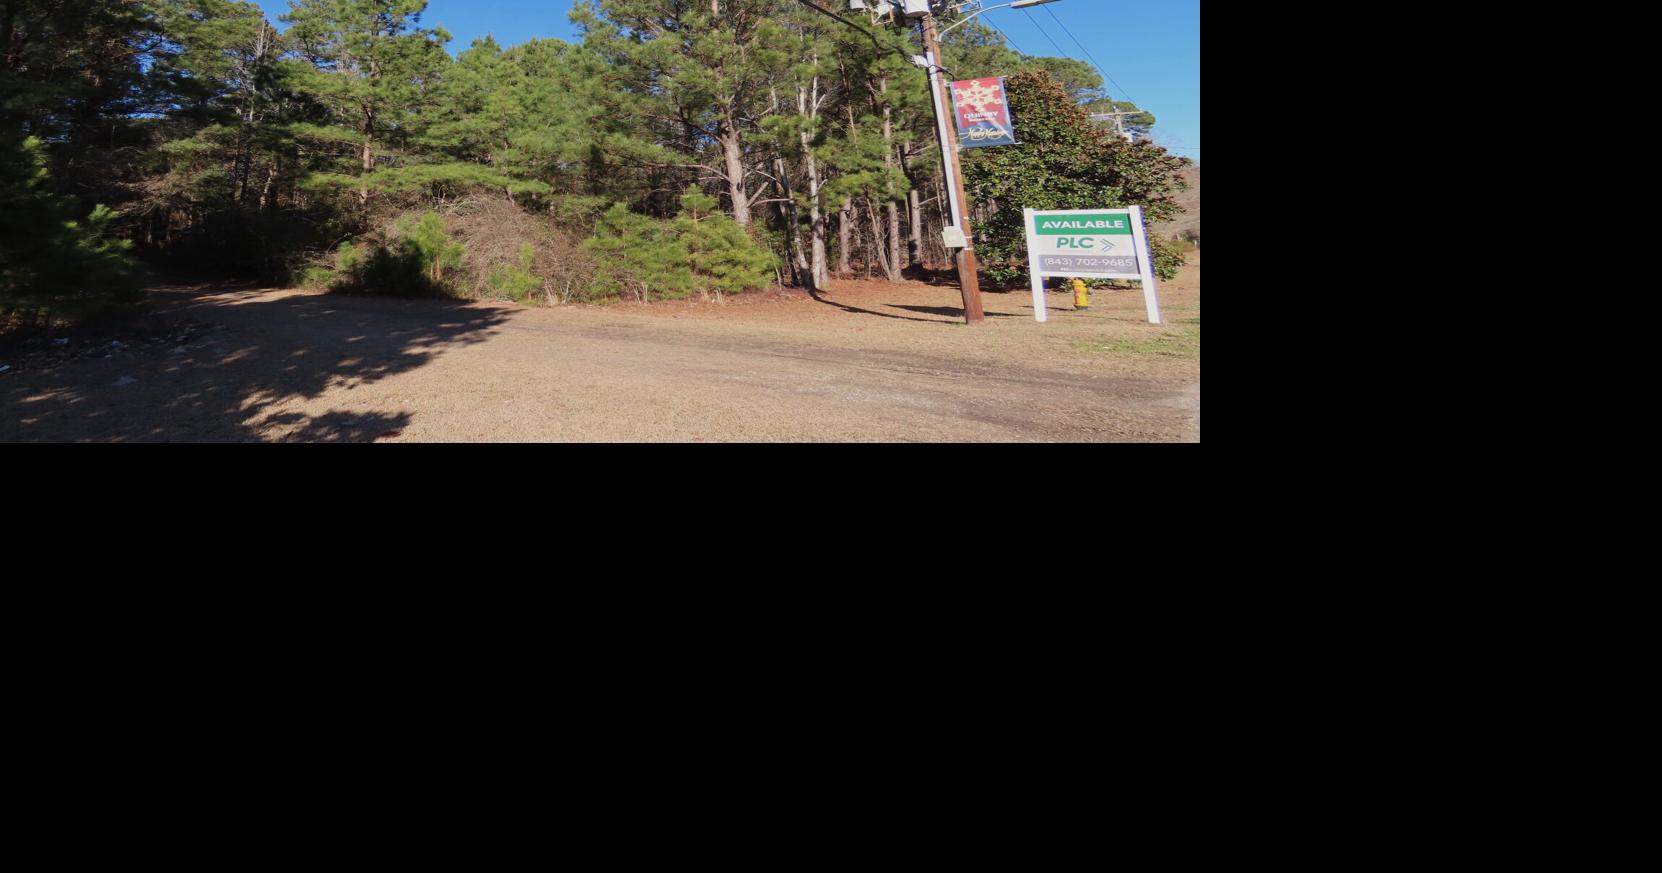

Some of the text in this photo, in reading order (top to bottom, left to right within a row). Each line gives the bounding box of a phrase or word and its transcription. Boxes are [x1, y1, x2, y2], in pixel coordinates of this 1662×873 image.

[1042, 220, 1124, 229] AVAILABLE
[1056, 237, 1095, 249] PLC
[1044, 257, 1133, 267] (843) 702-9685
